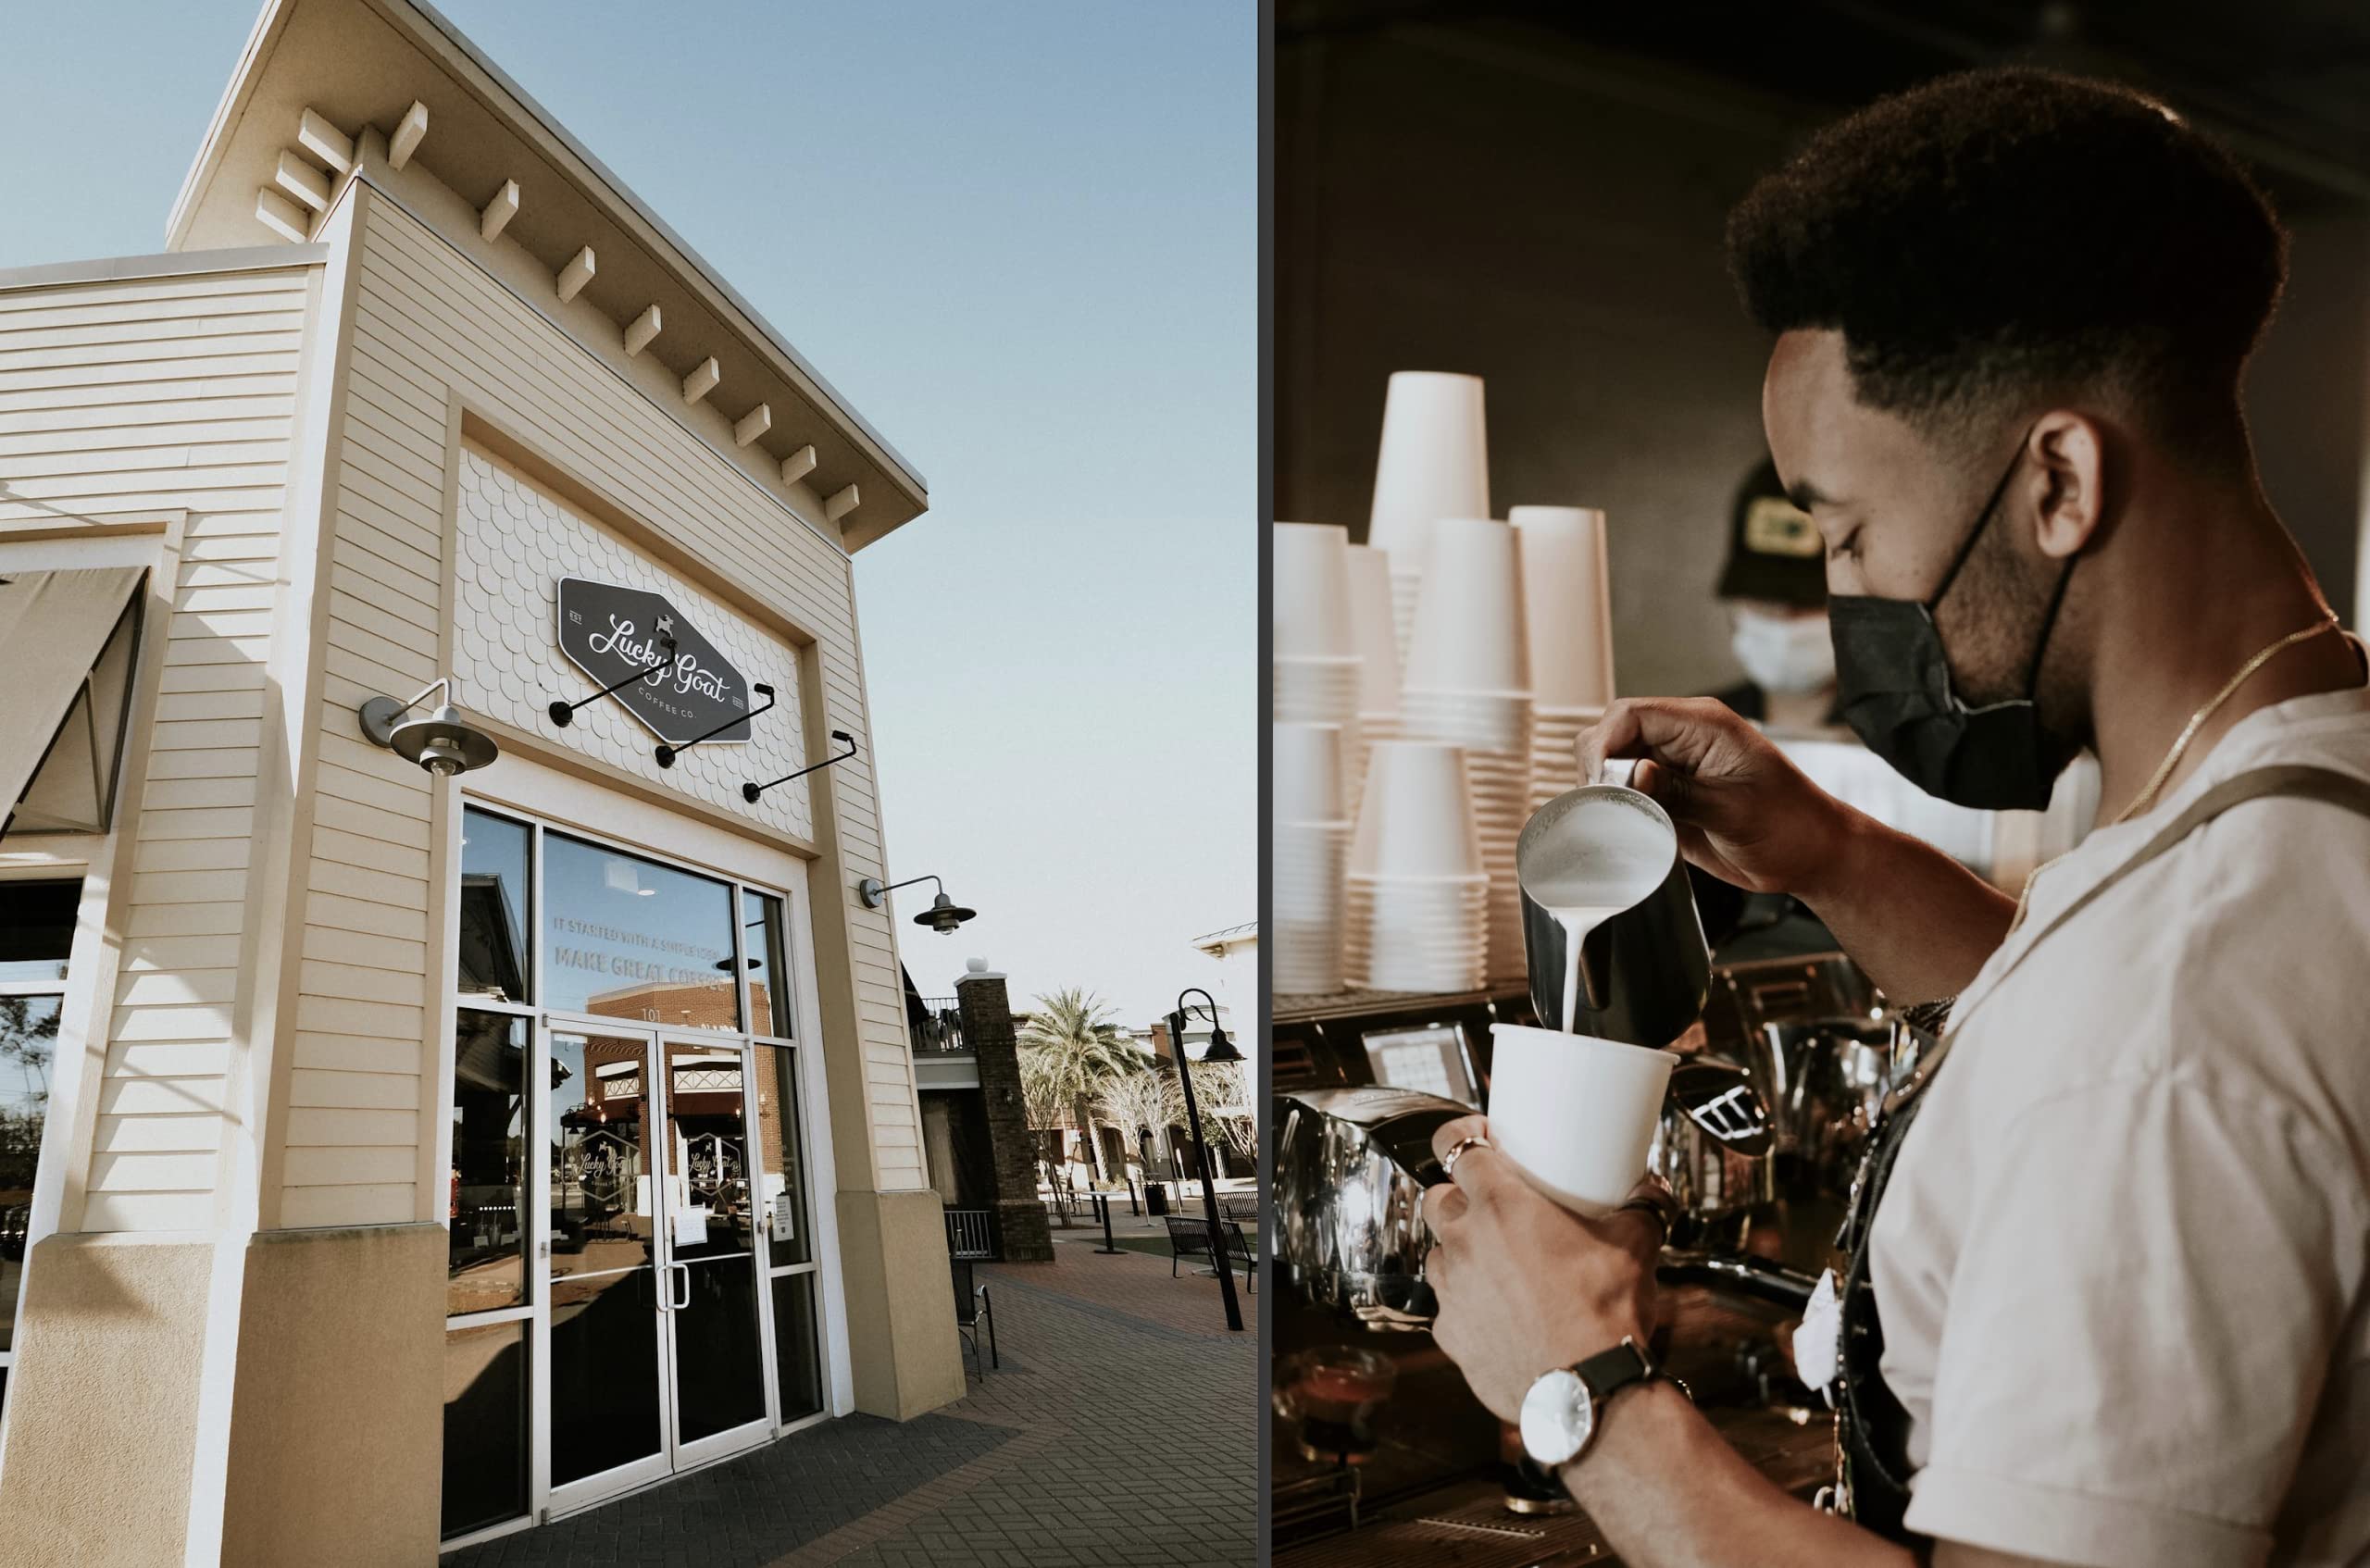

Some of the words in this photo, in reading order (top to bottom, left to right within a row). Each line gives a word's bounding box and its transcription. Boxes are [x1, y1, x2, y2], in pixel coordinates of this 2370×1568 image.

[589, 613, 673, 686] Lucky
[674, 653, 730, 703] Goat
[638, 687, 678, 715] COFFEE
[555, 946, 608, 973] MAKE
[611, 957, 666, 983] GREAT
[642, 1008, 661, 1023] 101
